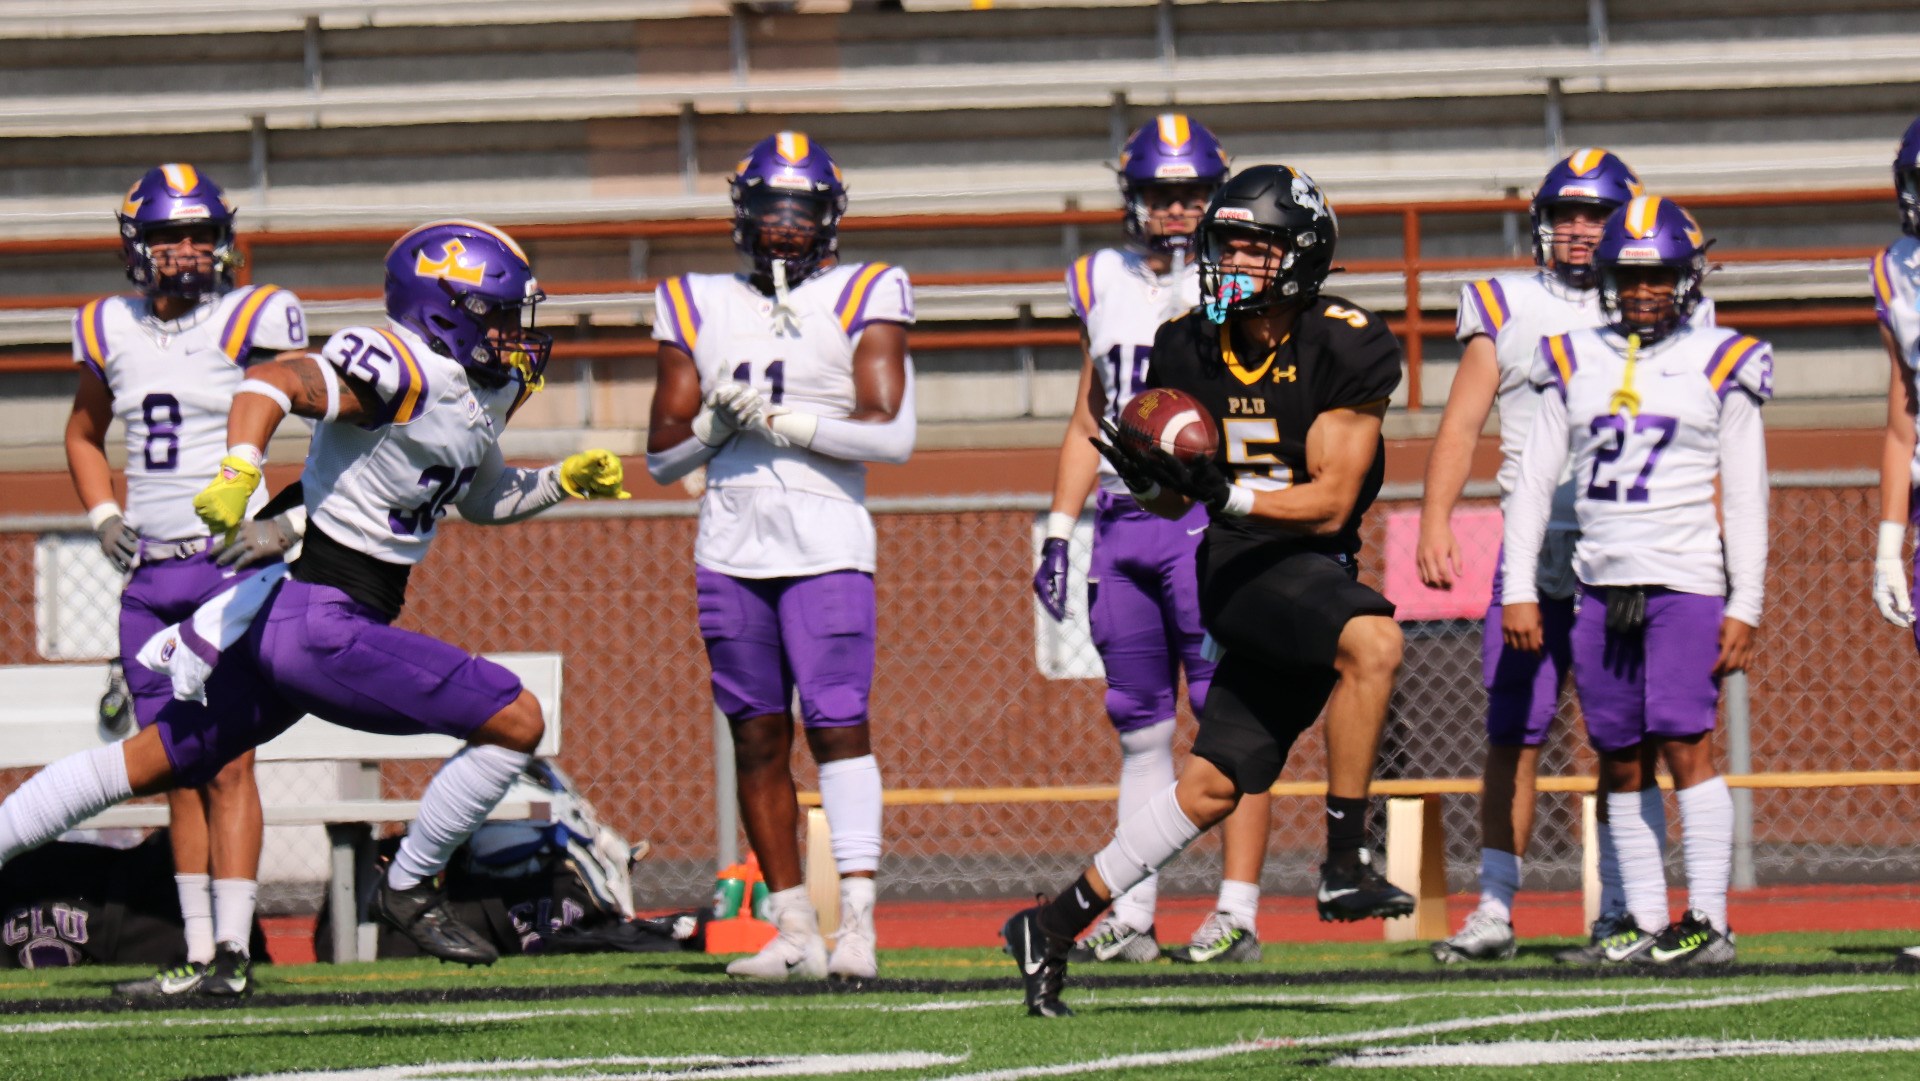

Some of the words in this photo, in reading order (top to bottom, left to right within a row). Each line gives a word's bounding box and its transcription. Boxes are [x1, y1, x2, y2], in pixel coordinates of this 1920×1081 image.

[285, 305, 304, 344] 8
[338, 333, 393, 388] 35
[142, 393, 182, 472] 8
[1228, 397, 1266, 414] PLU
[1222, 417, 1294, 492] 5
[1587, 413, 1678, 503] 27
[4, 903, 89, 946] CLU
